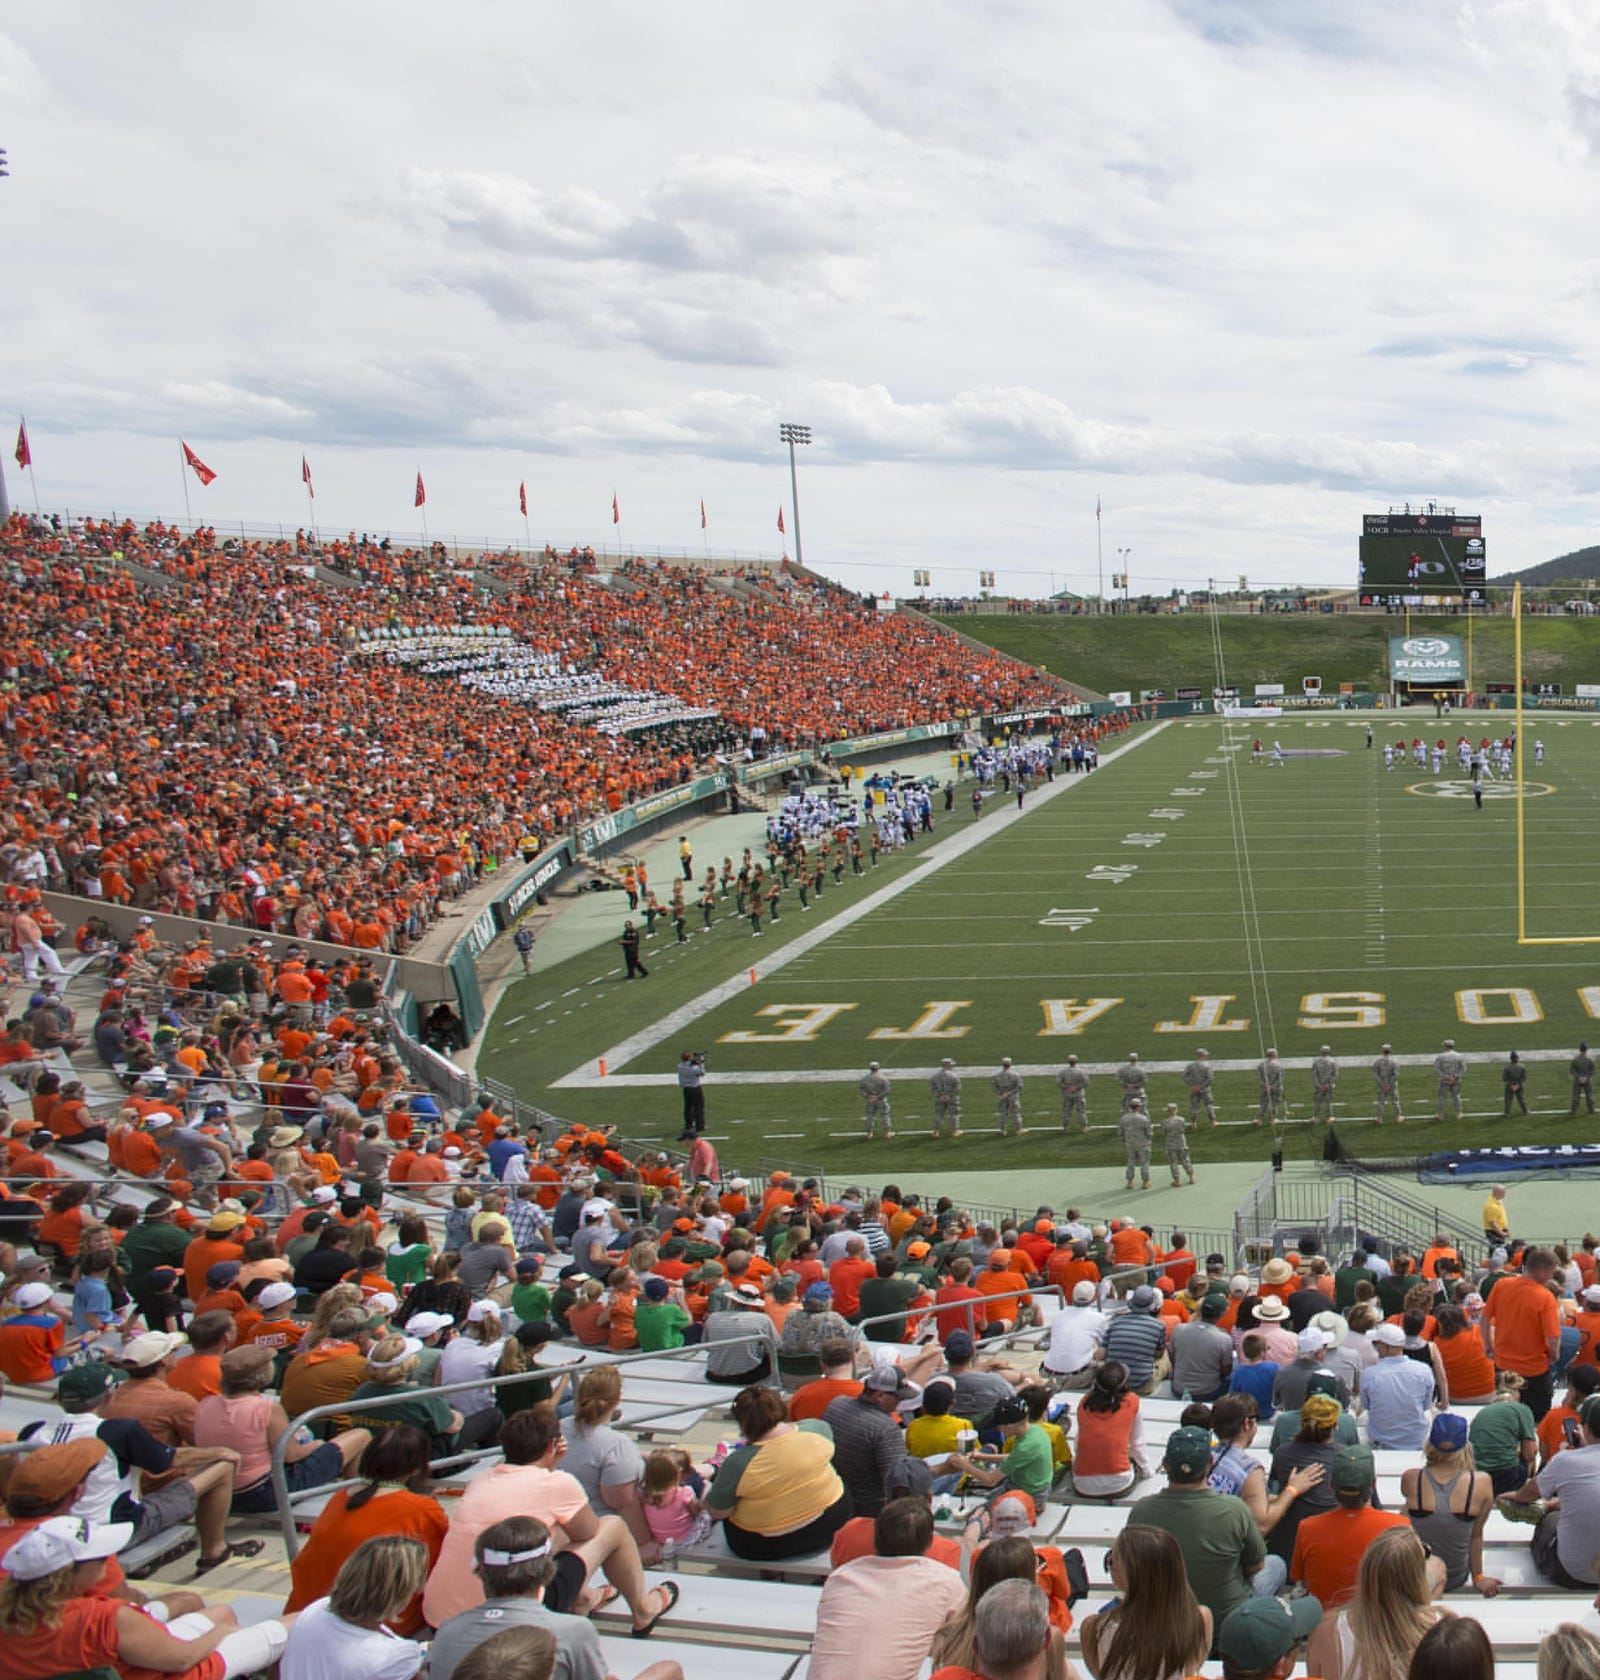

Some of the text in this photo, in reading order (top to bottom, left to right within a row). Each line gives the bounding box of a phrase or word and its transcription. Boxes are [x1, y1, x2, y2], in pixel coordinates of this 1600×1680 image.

[1395, 660, 1460, 668] RAMS
[1039, 907, 1099, 925] 10
[716, 991, 1387, 1044] STATE
